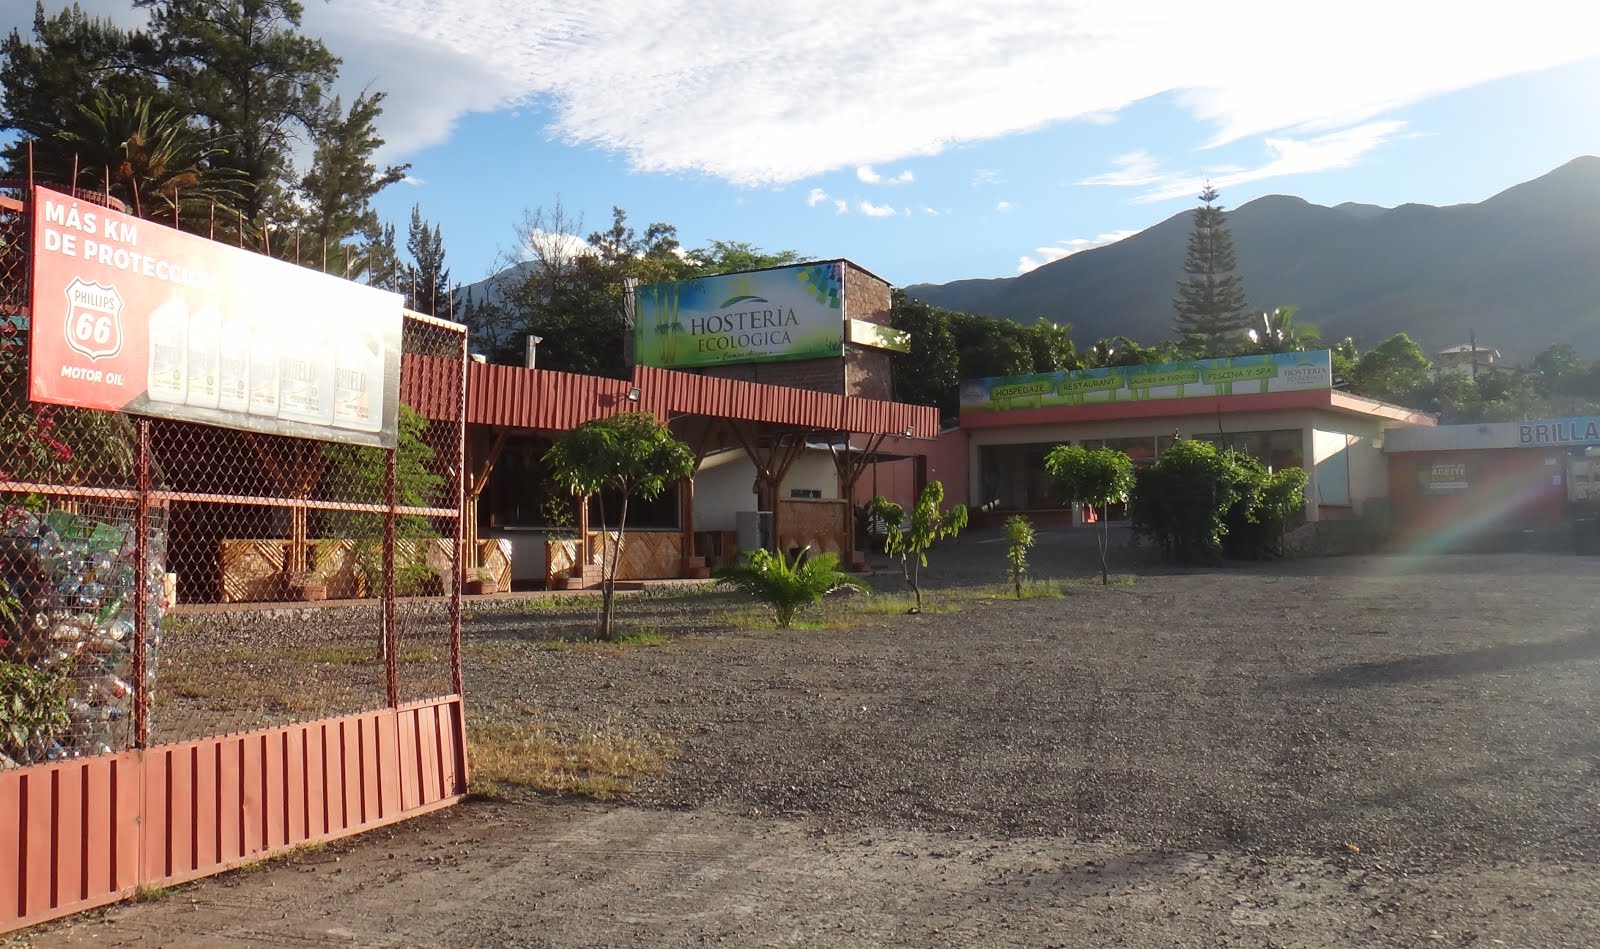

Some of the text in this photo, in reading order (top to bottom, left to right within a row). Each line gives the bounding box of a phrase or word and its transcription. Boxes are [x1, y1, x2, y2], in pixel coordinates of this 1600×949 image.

[44, 202, 138, 246] MÁS KM
[44, 229, 78, 257] DE
[74, 289, 115, 311] PHILLIPS
[75, 312, 113, 345] 66
[691, 304, 800, 336] HOSTERÍA
[698, 330, 792, 353] ECOLÓGICA
[61, 365, 124, 386] MOTOR OIL
[1063, 378, 1116, 391] RESTAURANT
[1207, 367, 1272, 381] PISCINA Y SPA
[995, 383, 1045, 397] HOSPEDAJE
[1519, 421, 1600, 444] BRILLA
